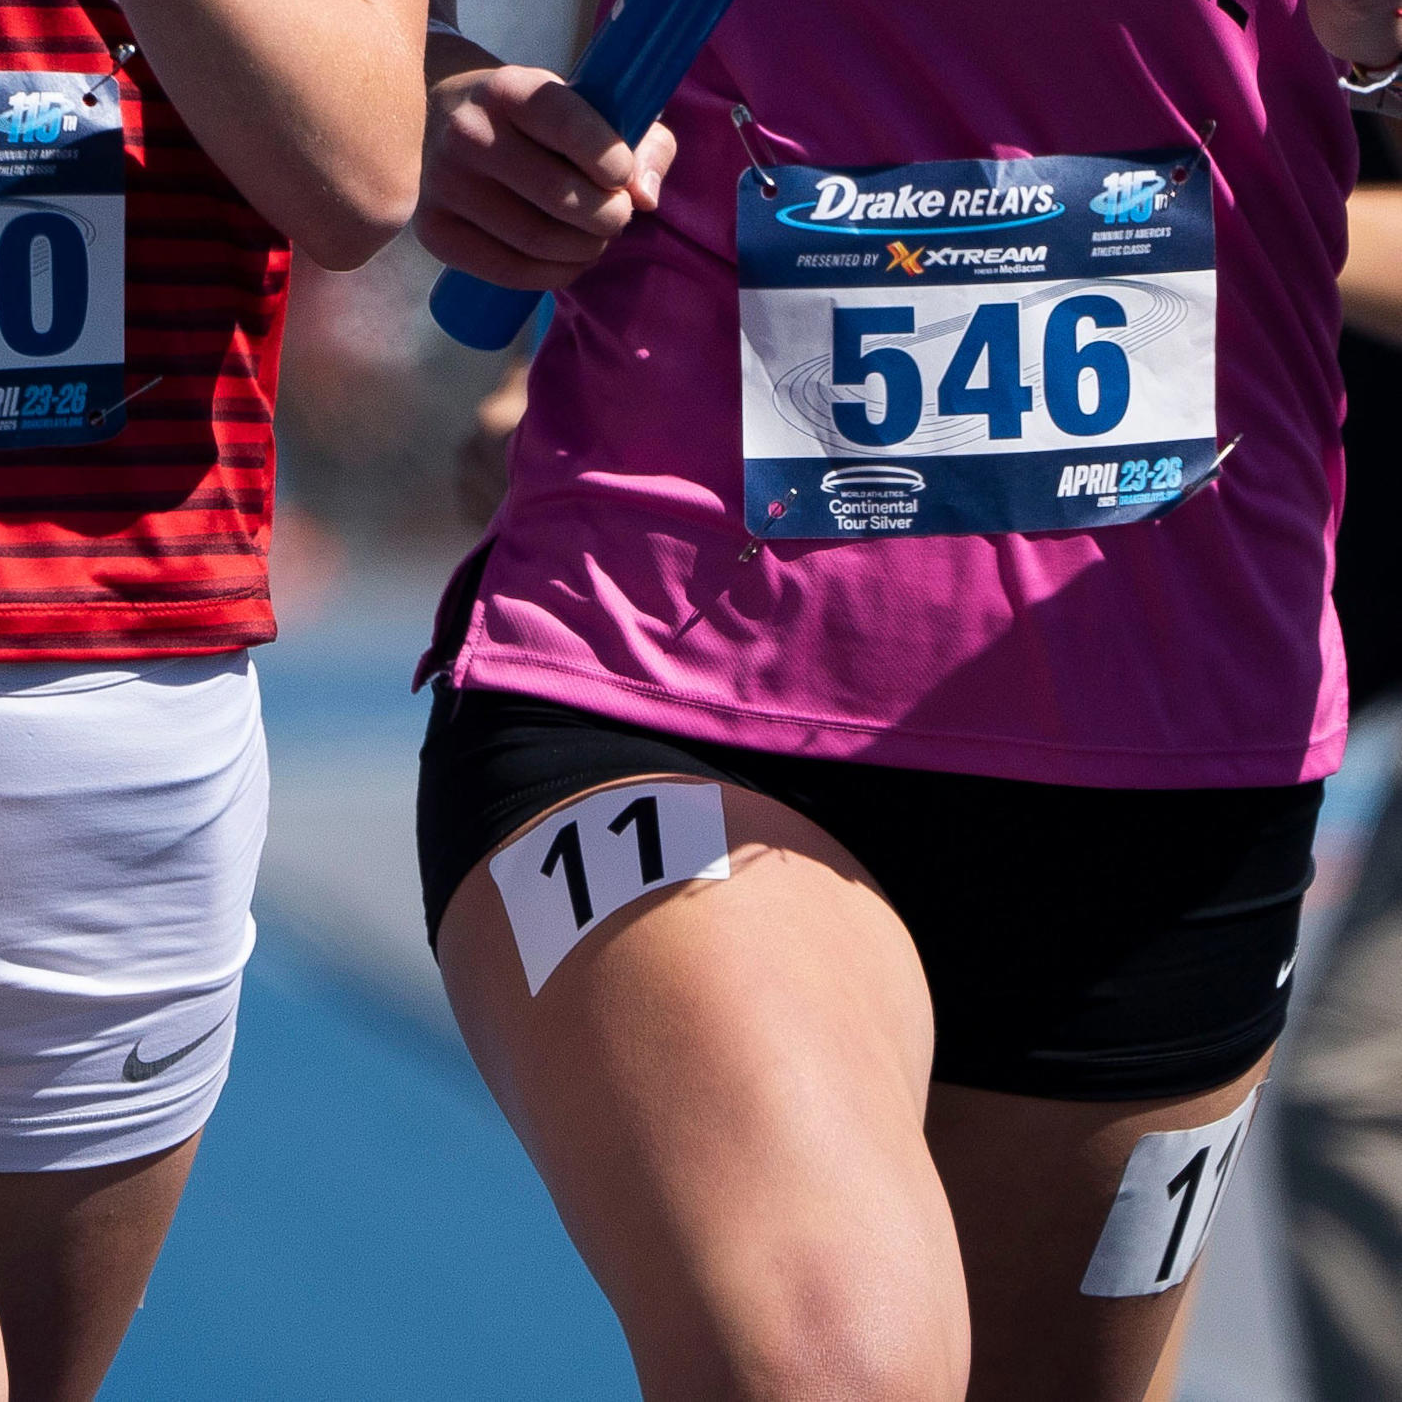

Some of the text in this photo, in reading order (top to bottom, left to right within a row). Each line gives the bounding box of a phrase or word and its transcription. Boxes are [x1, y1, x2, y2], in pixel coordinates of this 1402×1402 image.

[810, 175, 945, 220] Drake
[796, 253, 879, 267] PRESENTED BY
[923, 245, 1048, 266] XTREAM
[830, 294, 1130, 447] 546
[21, 383, 87, 416] 23-26
[1057, 456, 1183, 497] APRIL 23-26
[829, 499, 918, 514] Continental
[834, 515, 913, 530] Tour Silver
[539, 796, 665, 931] 11
